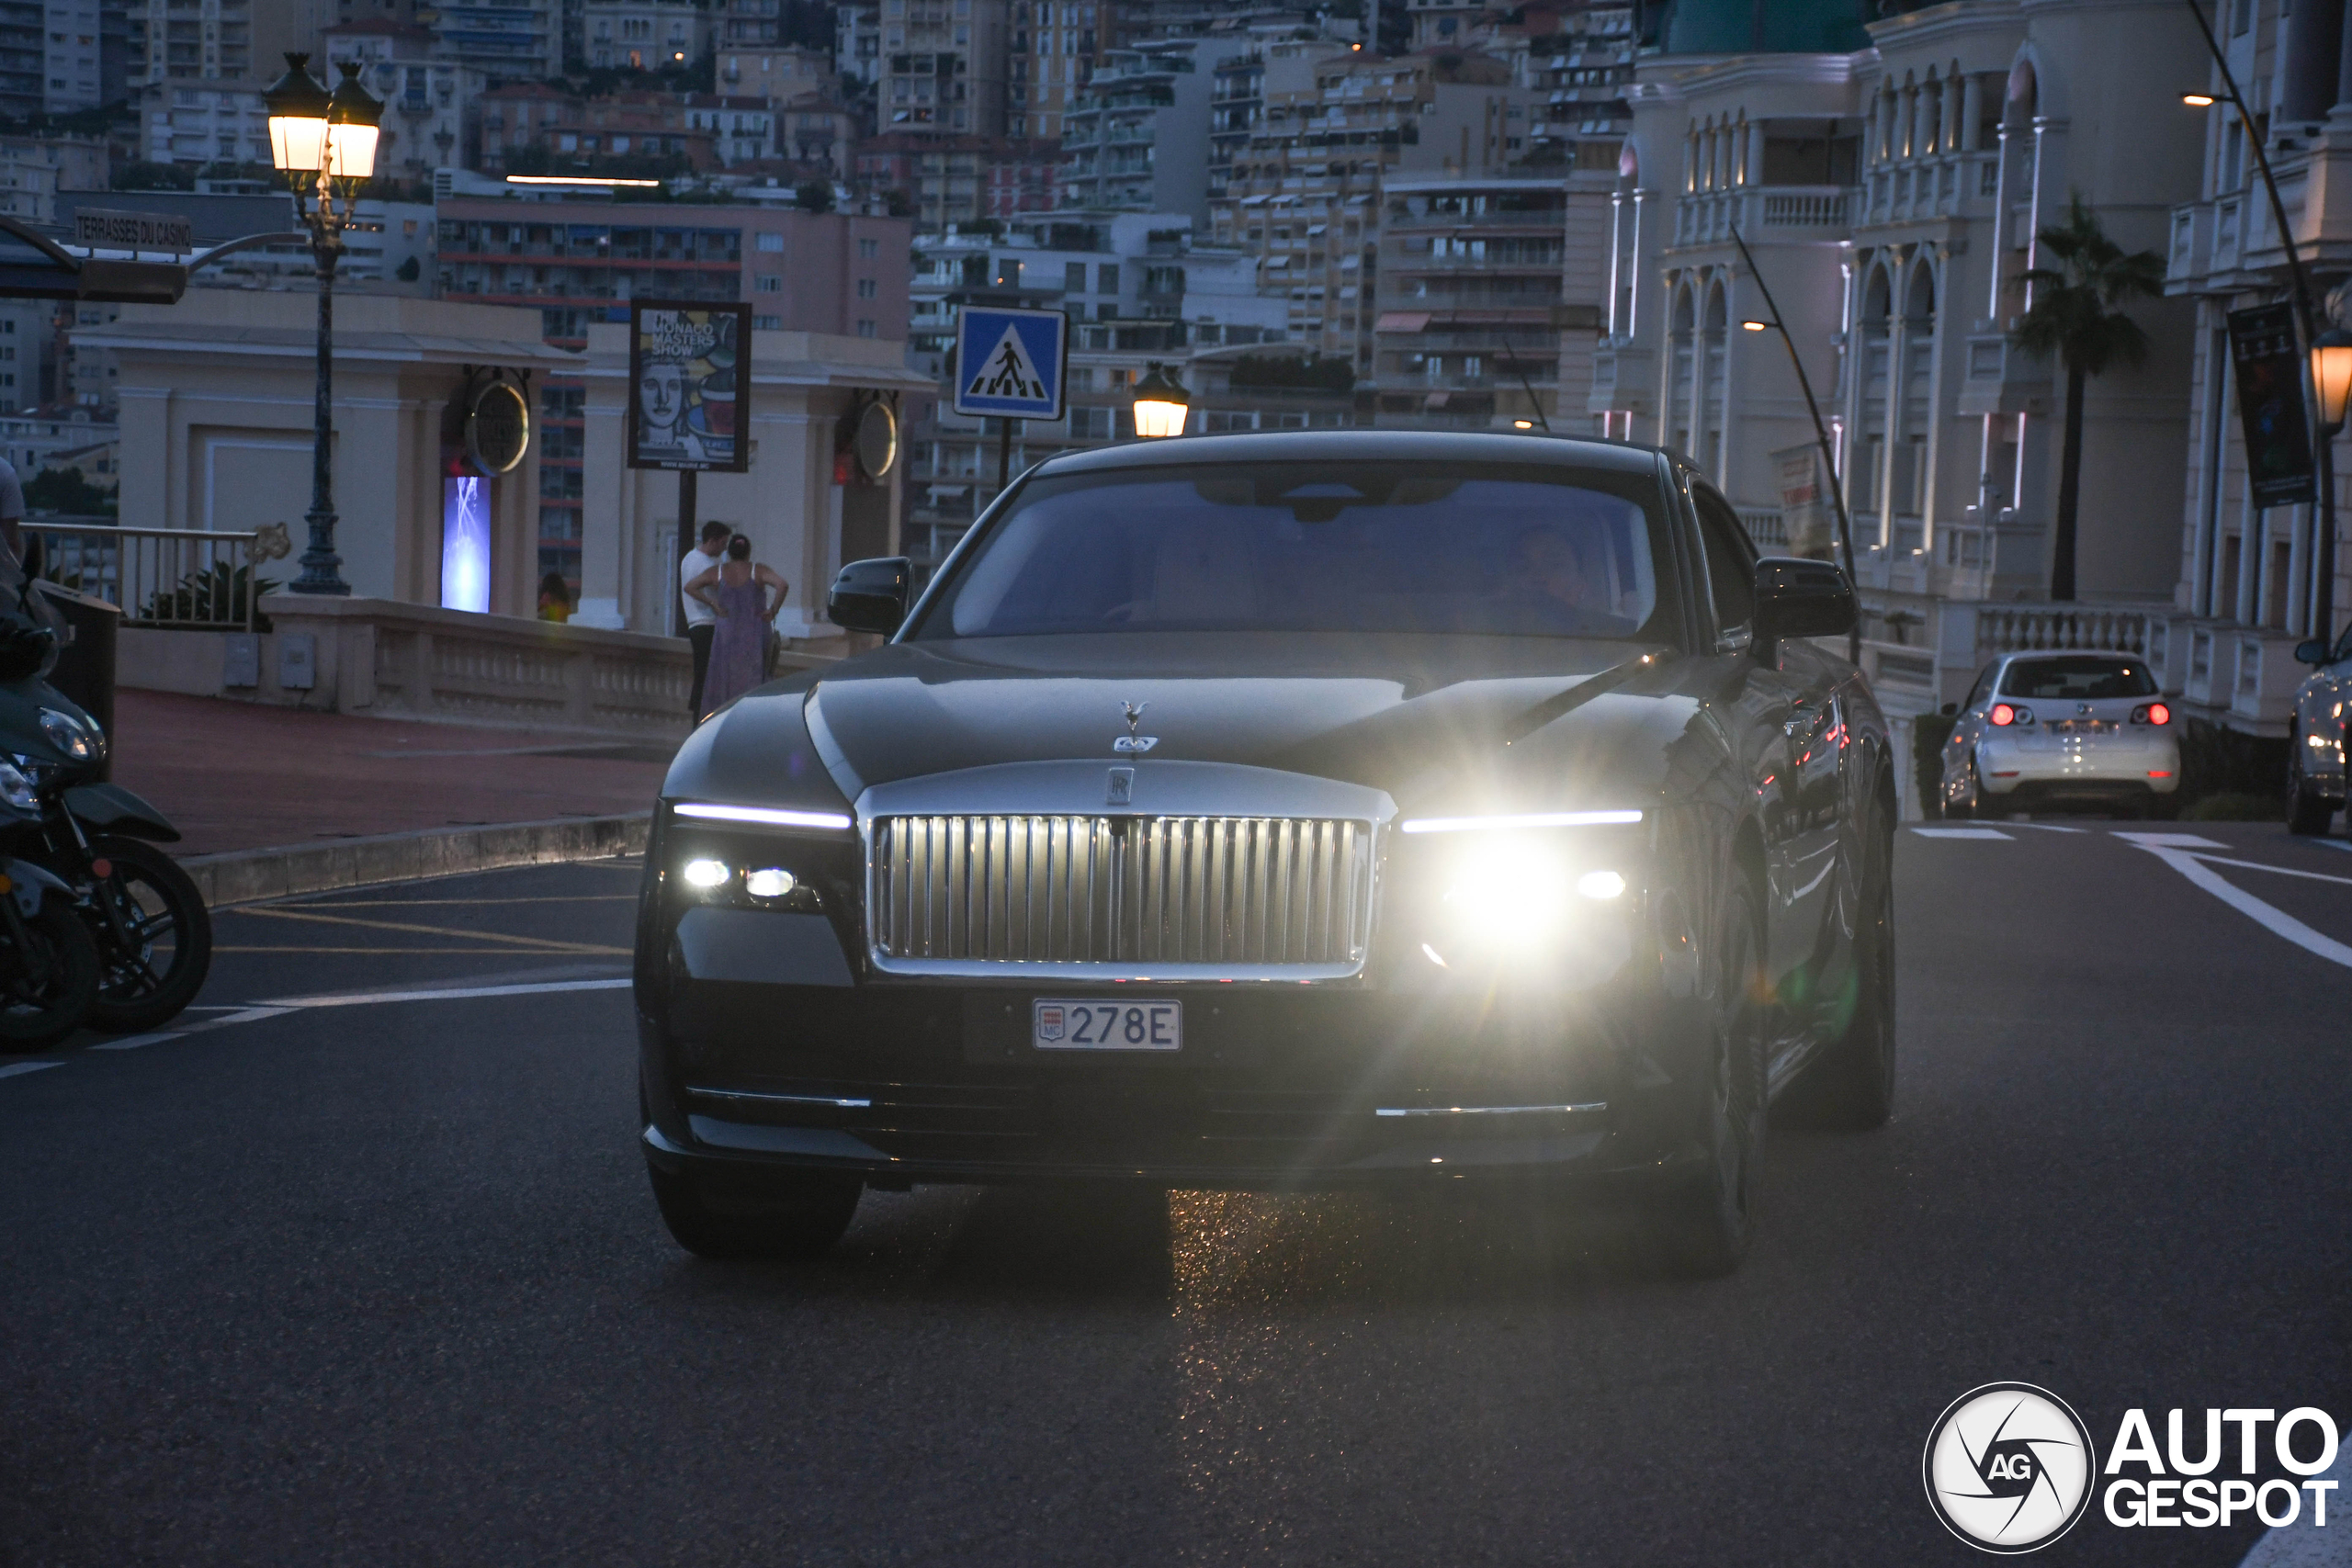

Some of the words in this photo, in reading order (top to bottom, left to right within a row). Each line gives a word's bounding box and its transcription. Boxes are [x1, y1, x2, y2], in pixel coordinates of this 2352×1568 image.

[76, 215, 139, 243] TERRASSES
[140, 221, 154, 244] DU
[156, 221, 191, 247] CASINO
[652, 323, 714, 335] MONACO
[652, 333, 716, 346] MASTERS
[652, 344, 694, 356] SHOW
[1044, 1025, 1060, 1036] MC
[1070, 1006, 1172, 1044] 278E
